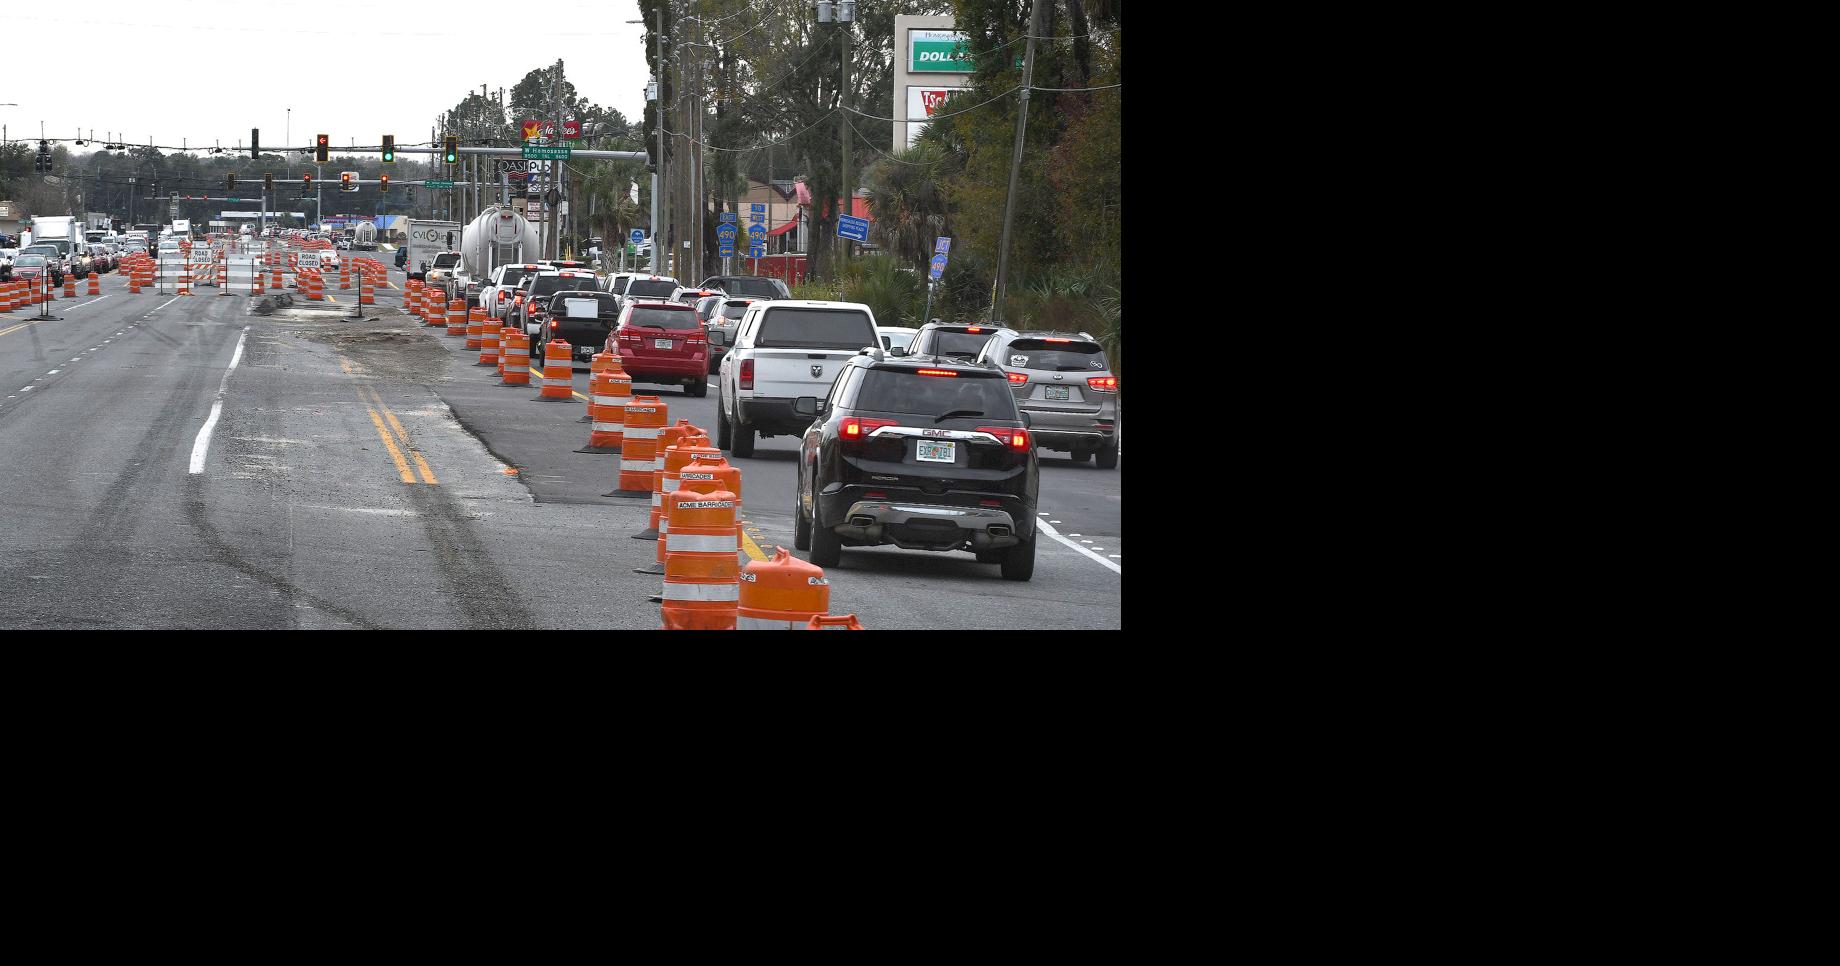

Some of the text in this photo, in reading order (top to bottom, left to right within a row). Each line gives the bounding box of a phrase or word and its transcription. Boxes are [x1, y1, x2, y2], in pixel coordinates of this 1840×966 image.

[720, 231, 735, 239] 490
[751, 231, 764, 240] 490
[936, 240, 950, 250] JCT
[932, 262, 945, 271] 490
[922, 429, 952, 438] GMC
